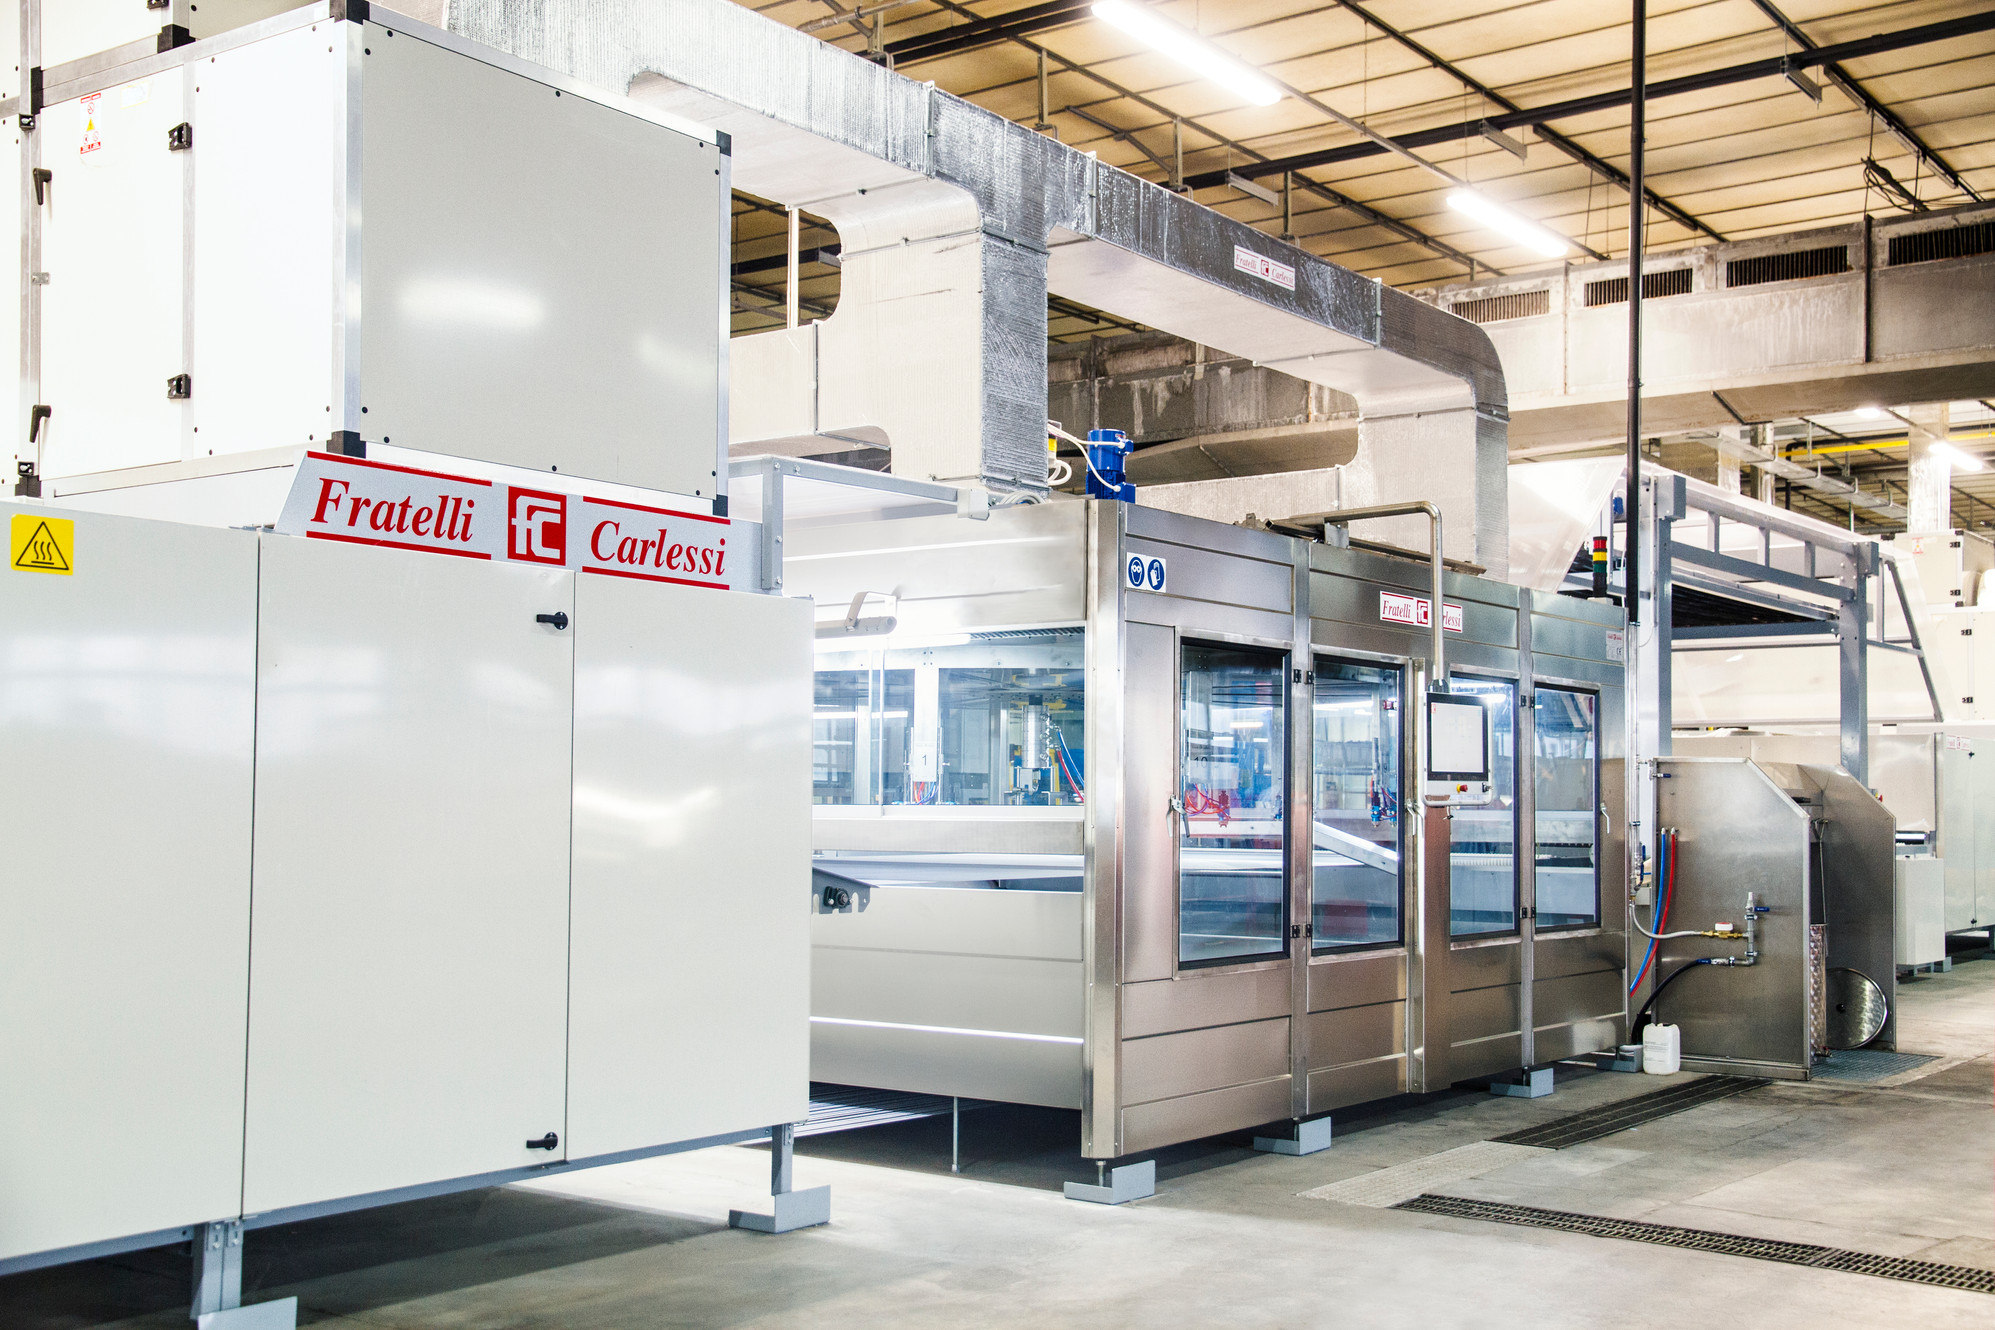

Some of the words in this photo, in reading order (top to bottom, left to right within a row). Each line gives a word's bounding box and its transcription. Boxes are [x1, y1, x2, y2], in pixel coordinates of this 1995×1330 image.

[1236, 253, 1257, 270] Fratelli
[1271, 268, 1294, 285] Carlessi
[310, 477, 475, 543] Fratelli
[590, 519, 727, 576] Carlessi
[1382, 600, 1412, 619] Fratelli
[1442, 611, 1461, 627] rlessi
[922, 754, 927, 766] 1
[1194, 756, 1208, 769] 10
